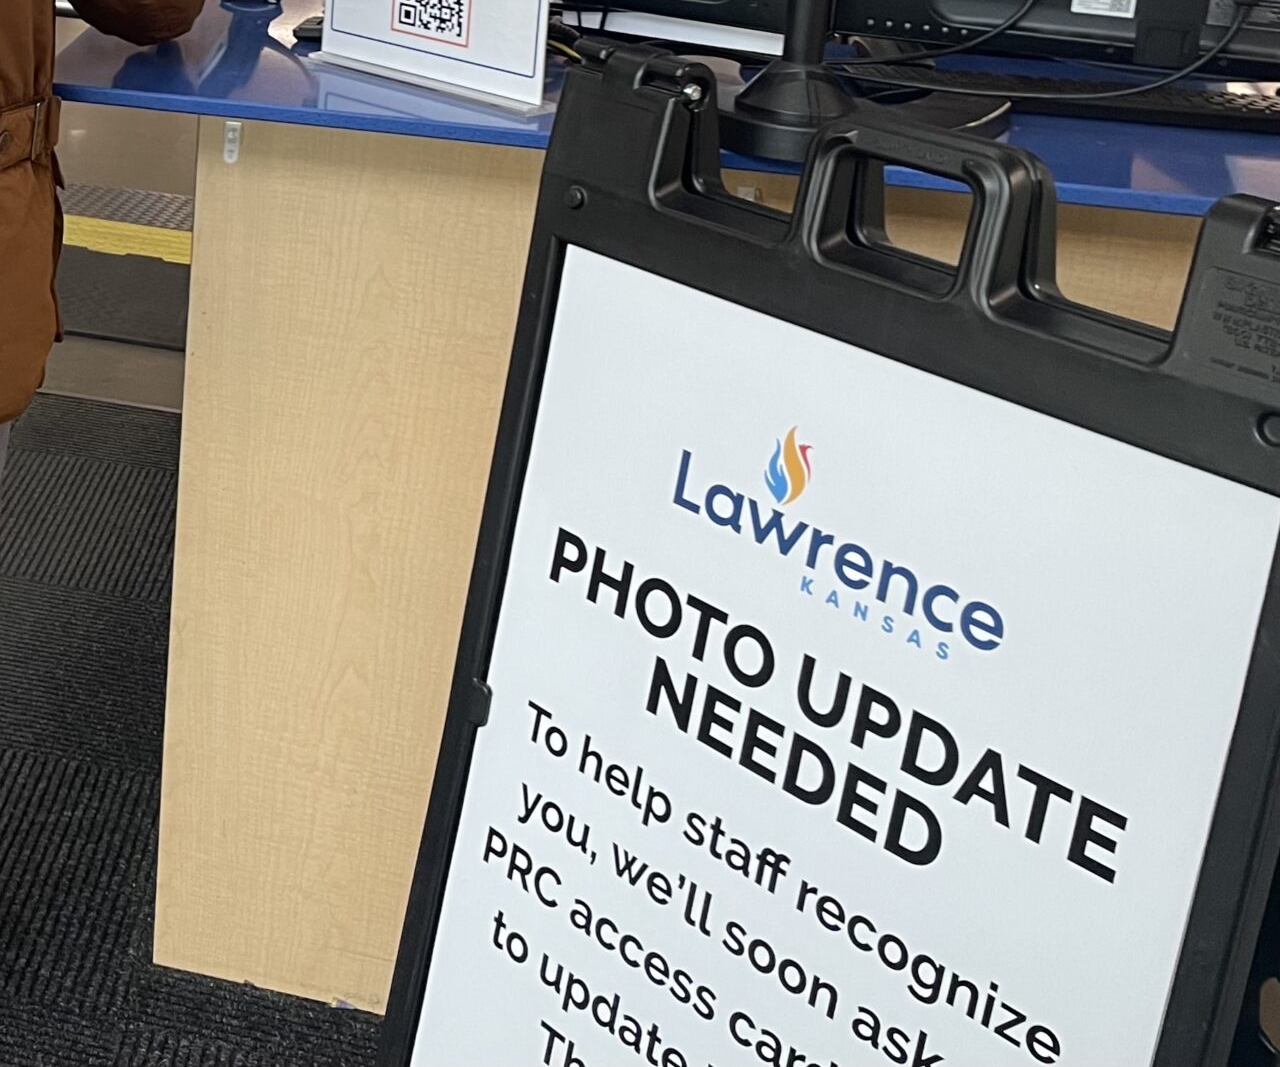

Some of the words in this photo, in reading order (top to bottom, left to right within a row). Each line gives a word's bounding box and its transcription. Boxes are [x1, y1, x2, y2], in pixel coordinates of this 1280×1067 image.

[673, 449, 1004, 651] Lawrence
[800, 575, 950, 660] KANSAS
[549, 527, 776, 688] PHOTO
[797, 653, 1128, 884] UPDATE
[646, 656, 943, 867] NEEDED
[483, 826, 563, 908] PRC
[570, 898, 718, 1021] access
[517, 781, 598, 866] you,
[612, 842, 713, 937] we'll
[722, 921, 839, 1021] soon
[852, 1006, 946, 1067] ask
[528, 700, 569, 757] To
[578, 734, 672, 827] help
[683, 812, 792, 895] staff
[796, 880, 1061, 1065] recognize
[493, 909, 529, 964] to
[540, 953, 688, 1067] update
